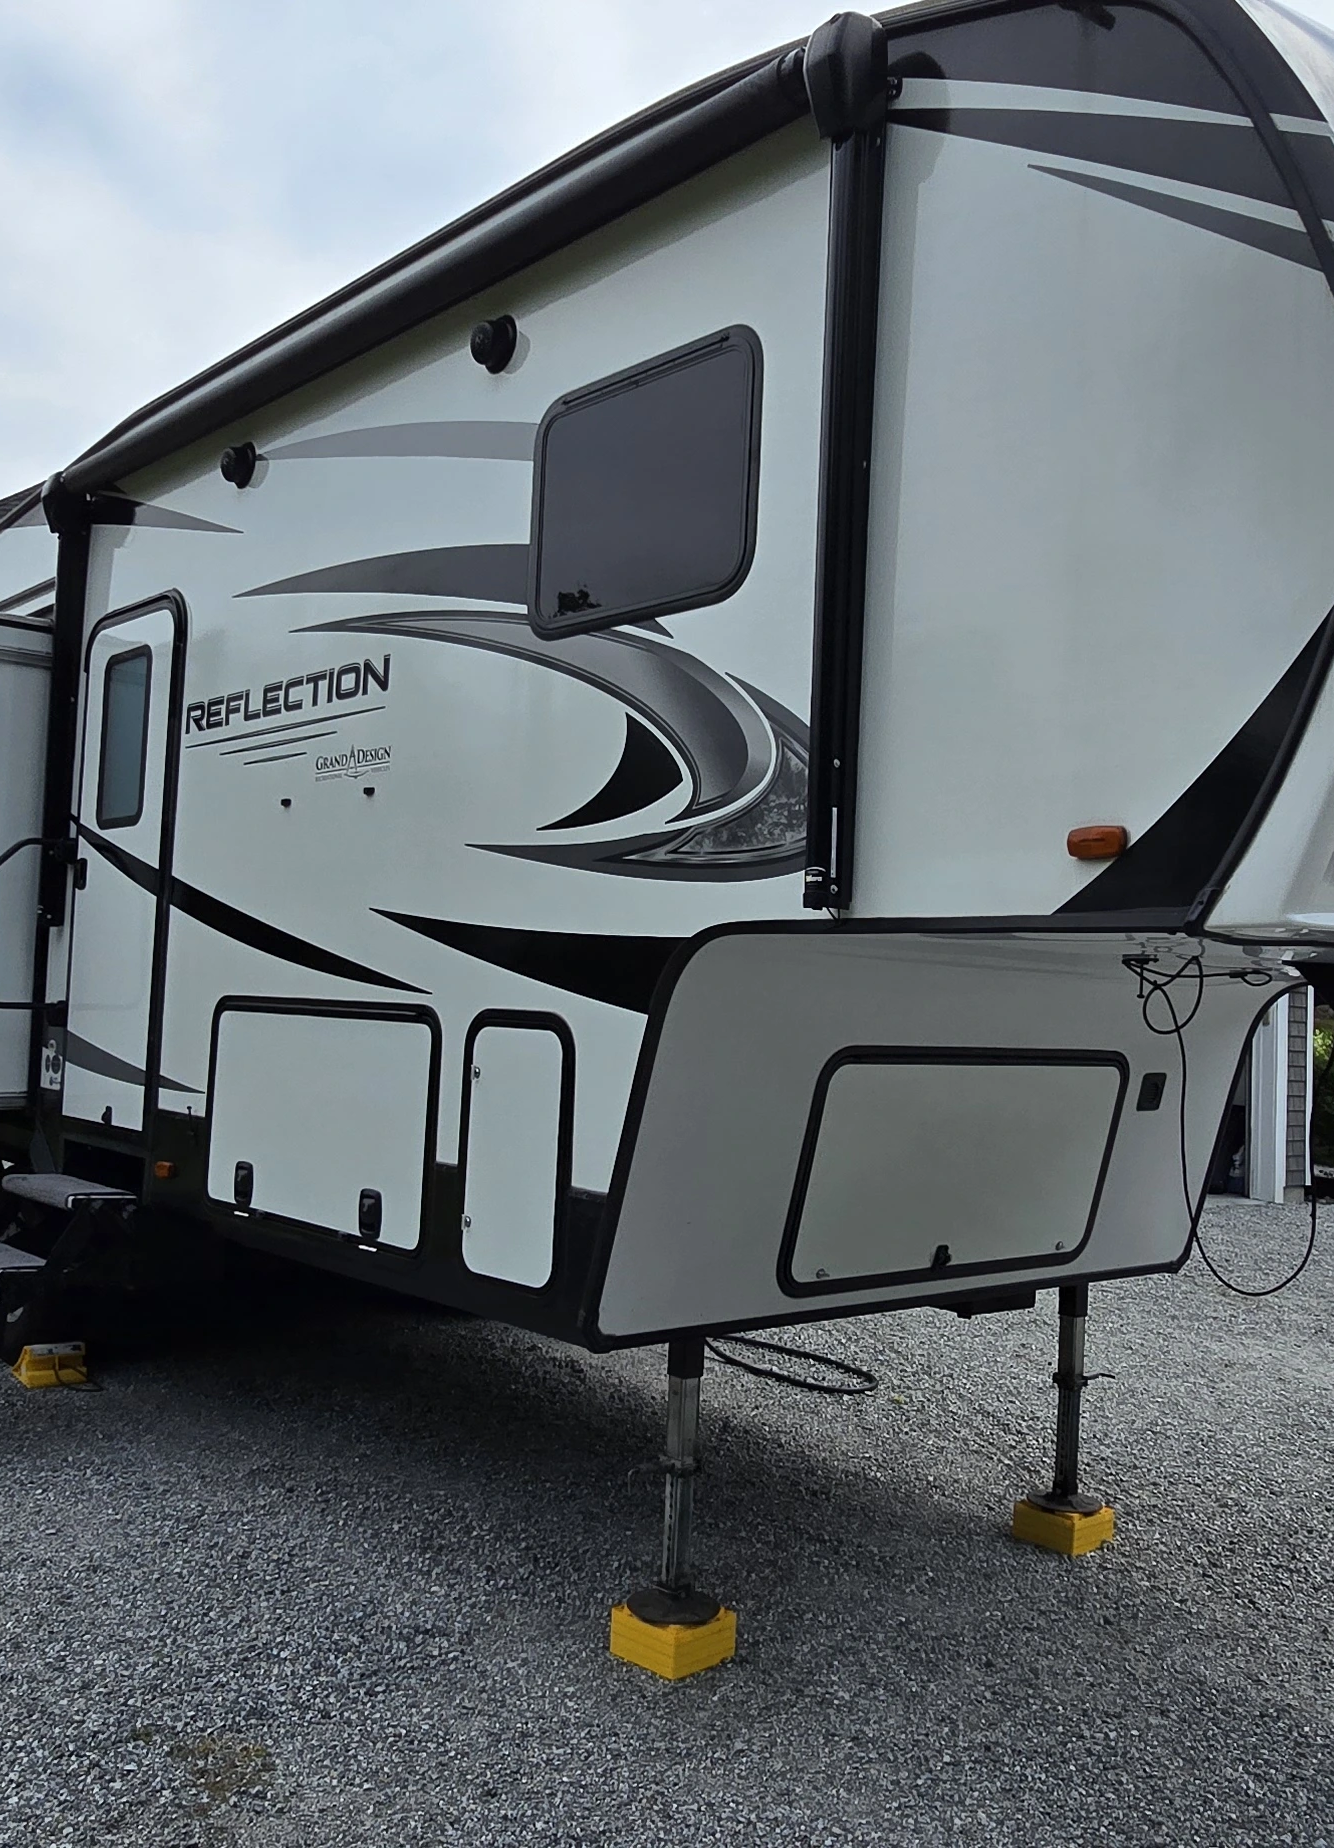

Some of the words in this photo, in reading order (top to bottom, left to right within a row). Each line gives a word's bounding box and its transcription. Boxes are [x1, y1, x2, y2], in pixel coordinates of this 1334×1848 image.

[185, 654, 391, 734] REFLECTION
[315, 754, 348, 771] GRAND
[357, 746, 392, 765] DESIGN
